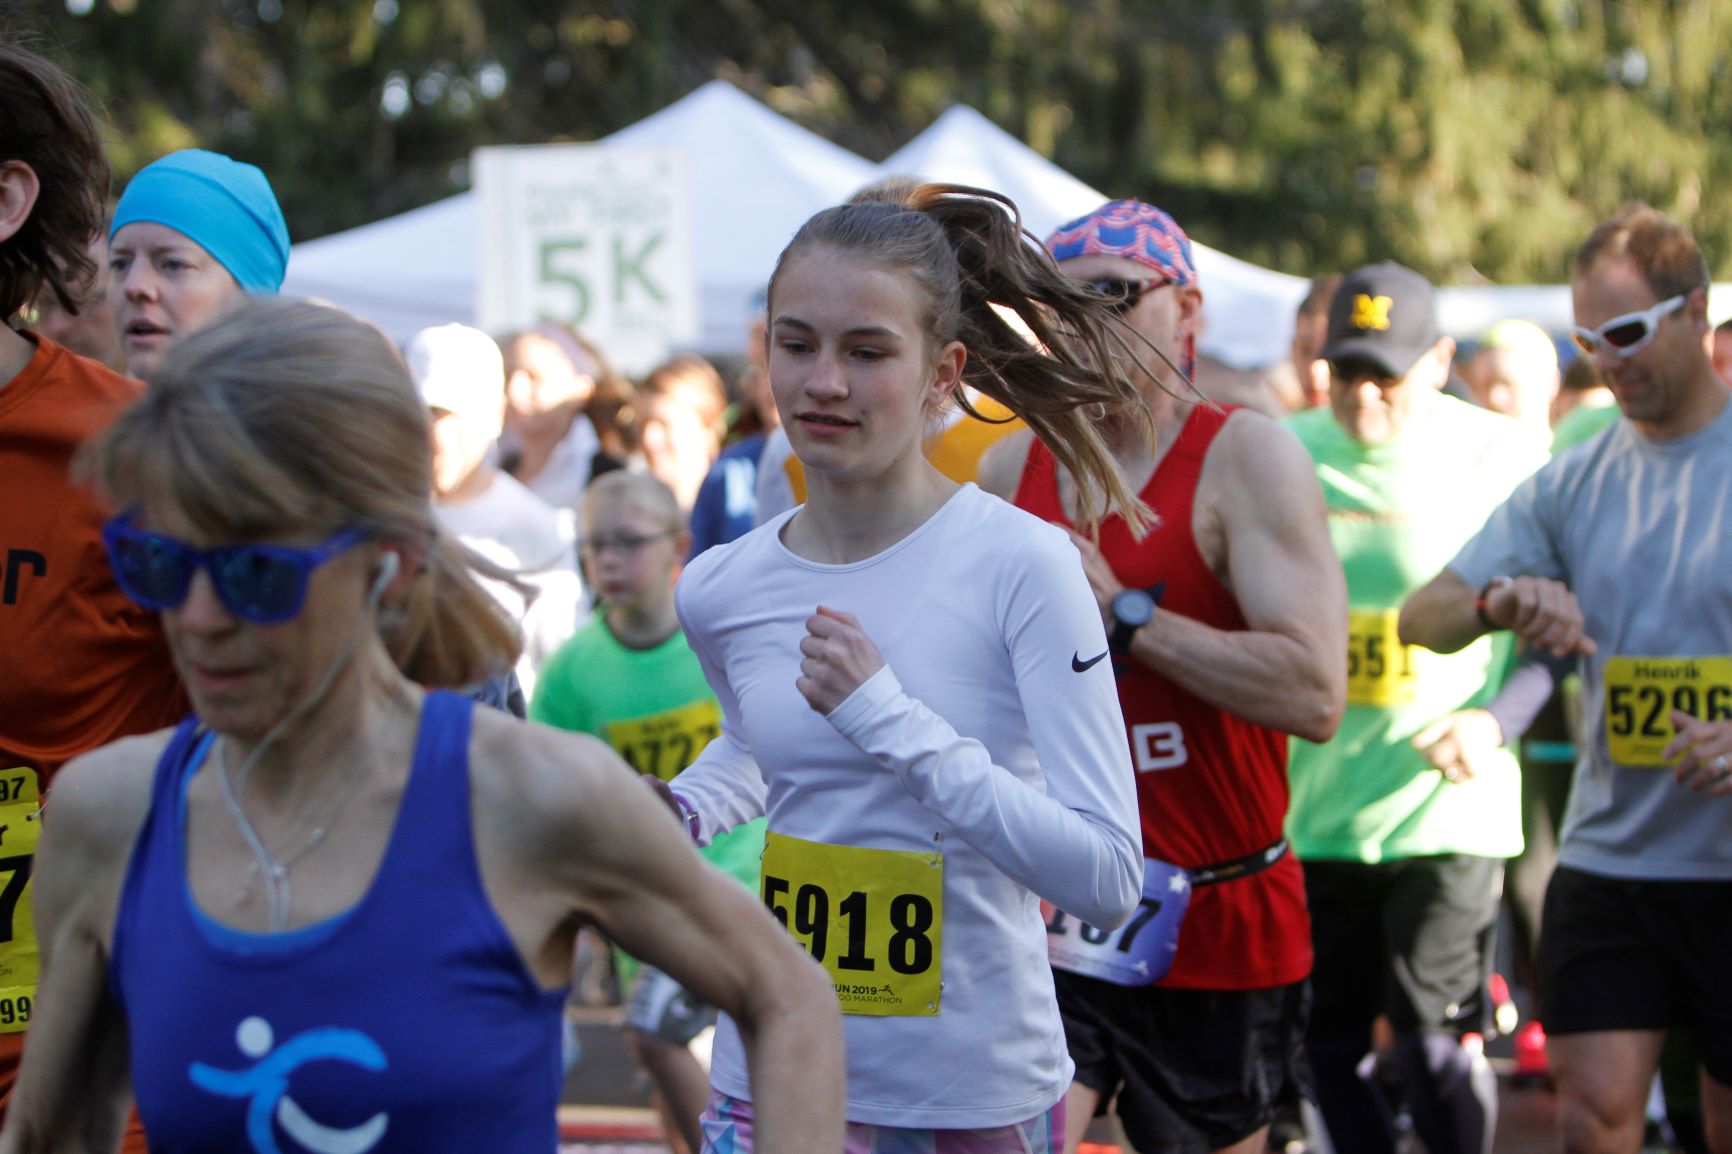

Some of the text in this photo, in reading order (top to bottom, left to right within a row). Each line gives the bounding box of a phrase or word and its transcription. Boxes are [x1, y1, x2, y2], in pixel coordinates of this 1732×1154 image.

[0, 548, 47, 605] r
[1132, 721, 1188, 773] B
[764, 875, 934, 975] 5918
[0, 995, 32, 1025] 99
[833, 984, 877, 995] UN 2019
[854, 995, 902, 1004] MARATHON
